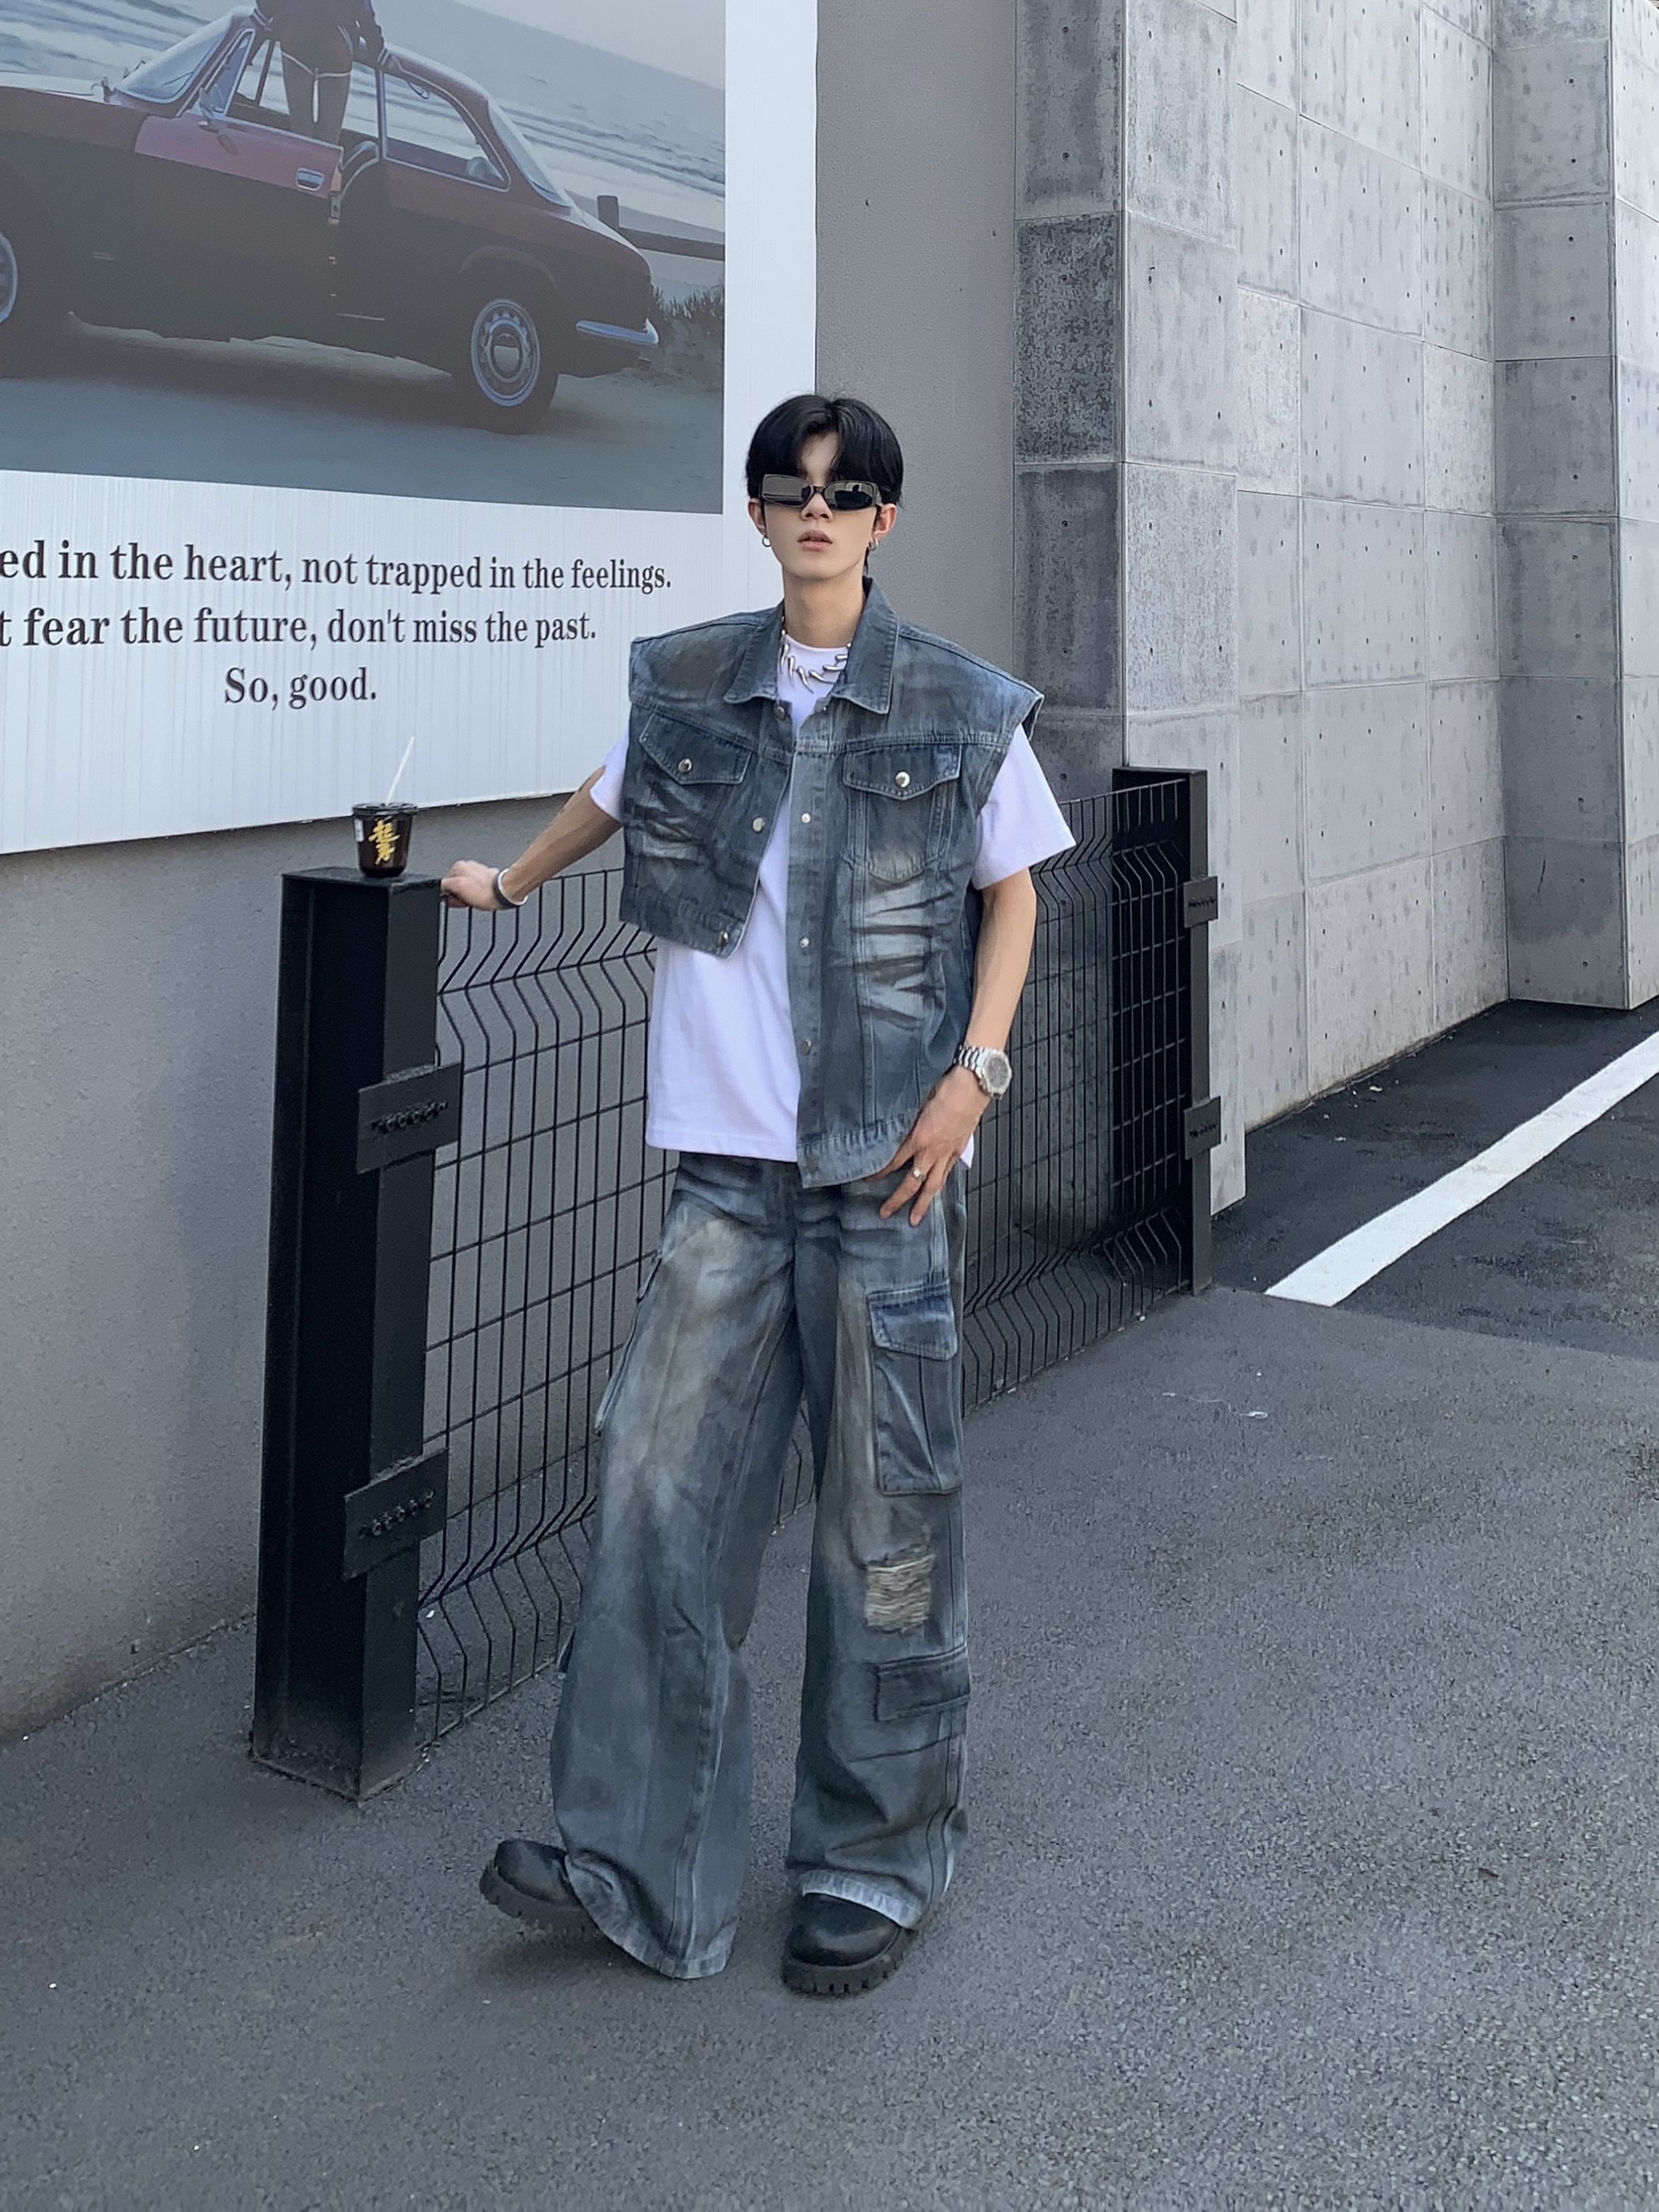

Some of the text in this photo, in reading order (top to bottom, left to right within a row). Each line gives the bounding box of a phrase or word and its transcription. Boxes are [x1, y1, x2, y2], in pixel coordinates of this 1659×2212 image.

[0, 540, 671, 595] ed in the heart, not trapped in the feelings.
[23, 607, 110, 646] fear
[120, 606, 183, 645] the
[194, 607, 317, 650] future,
[328, 608, 405, 643] don't
[412, 610, 477, 643] miss
[485, 611, 528, 643] the
[535, 612, 596, 649] past.
[225, 667, 377, 710] So, good.
